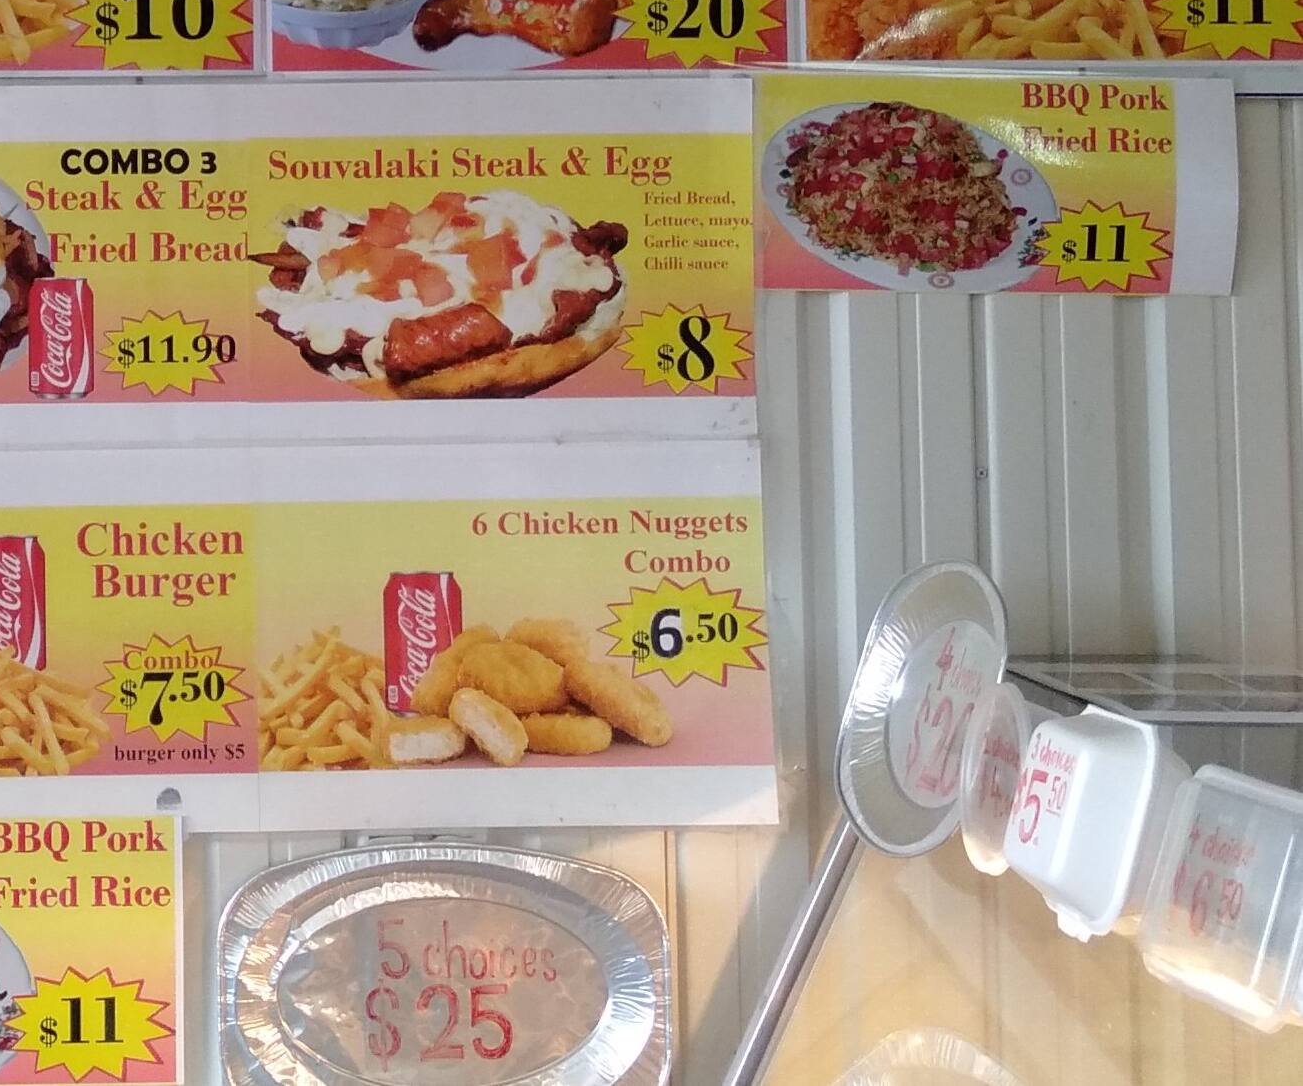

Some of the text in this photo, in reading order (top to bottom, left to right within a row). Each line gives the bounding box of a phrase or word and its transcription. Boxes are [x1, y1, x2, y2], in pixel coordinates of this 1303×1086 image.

[1022, 83, 1168, 114] BBQ Pork
[1023, 127, 1173, 154] Fried Rice
[61, 148, 217, 175] COMBO 3
[268, 146, 673, 186] Souvalaki Steak & Egg
[644, 191, 735, 205] Fried Bread,
[49, 232, 249, 263] Fried Bread
[644, 235, 688, 248] Garlic
[1062, 224, 1130, 264] $11
[644, 257, 728, 270] Chilli sauce
[657, 315, 714, 382] $8
[76, 522, 244, 557] Chicken
[471, 510, 748, 540] 6 Chicken Nuggets
[92, 563, 236, 607] Burger
[632, 608, 738, 662] $6.50
[123, 650, 216, 672] Combo
[120, 670, 225, 726] $7.50
[114, 743, 245, 765] burger only $5
[376, 918, 558, 982] 5 choices
